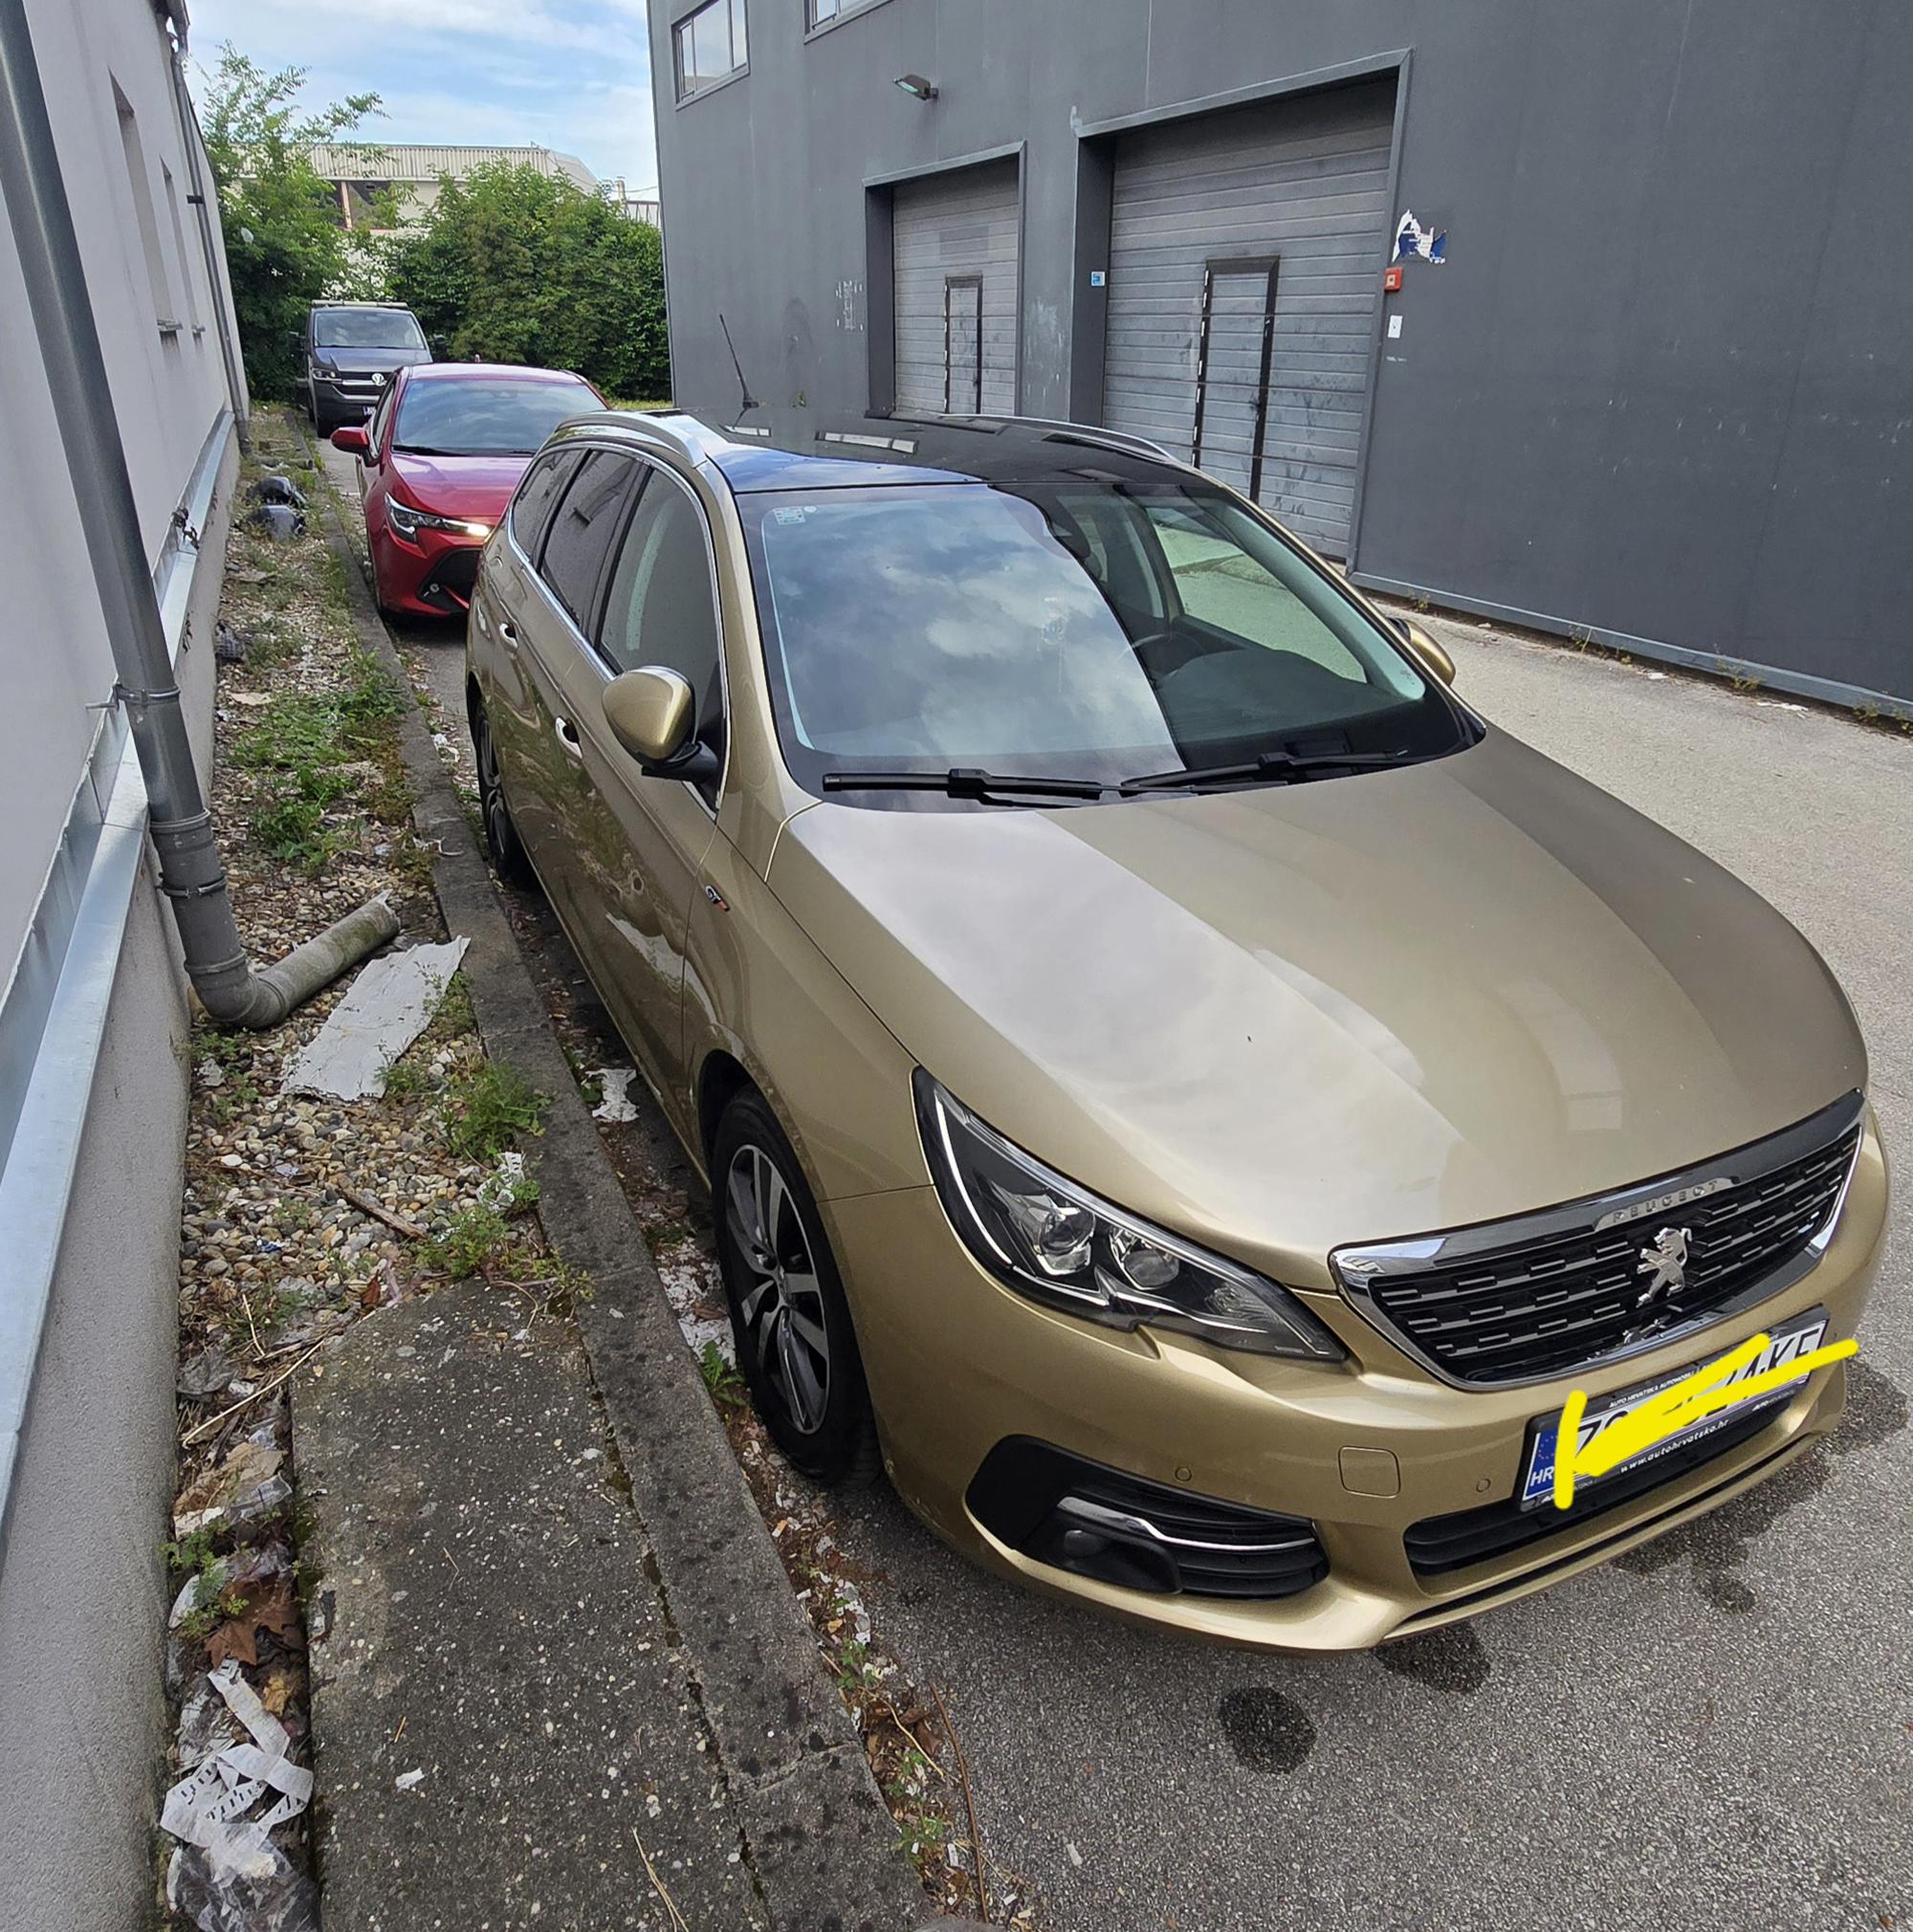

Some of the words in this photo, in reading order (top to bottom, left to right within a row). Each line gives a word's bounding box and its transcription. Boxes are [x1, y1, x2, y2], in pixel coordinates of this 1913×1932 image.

[1614, 1180, 1718, 1222] PEUGEOT
[1609, 1397, 1627, 1408] AUTO
[1620, 1418, 1729, 1474] www.autohrvatska.hr
[1529, 1467, 1555, 1487] HR
